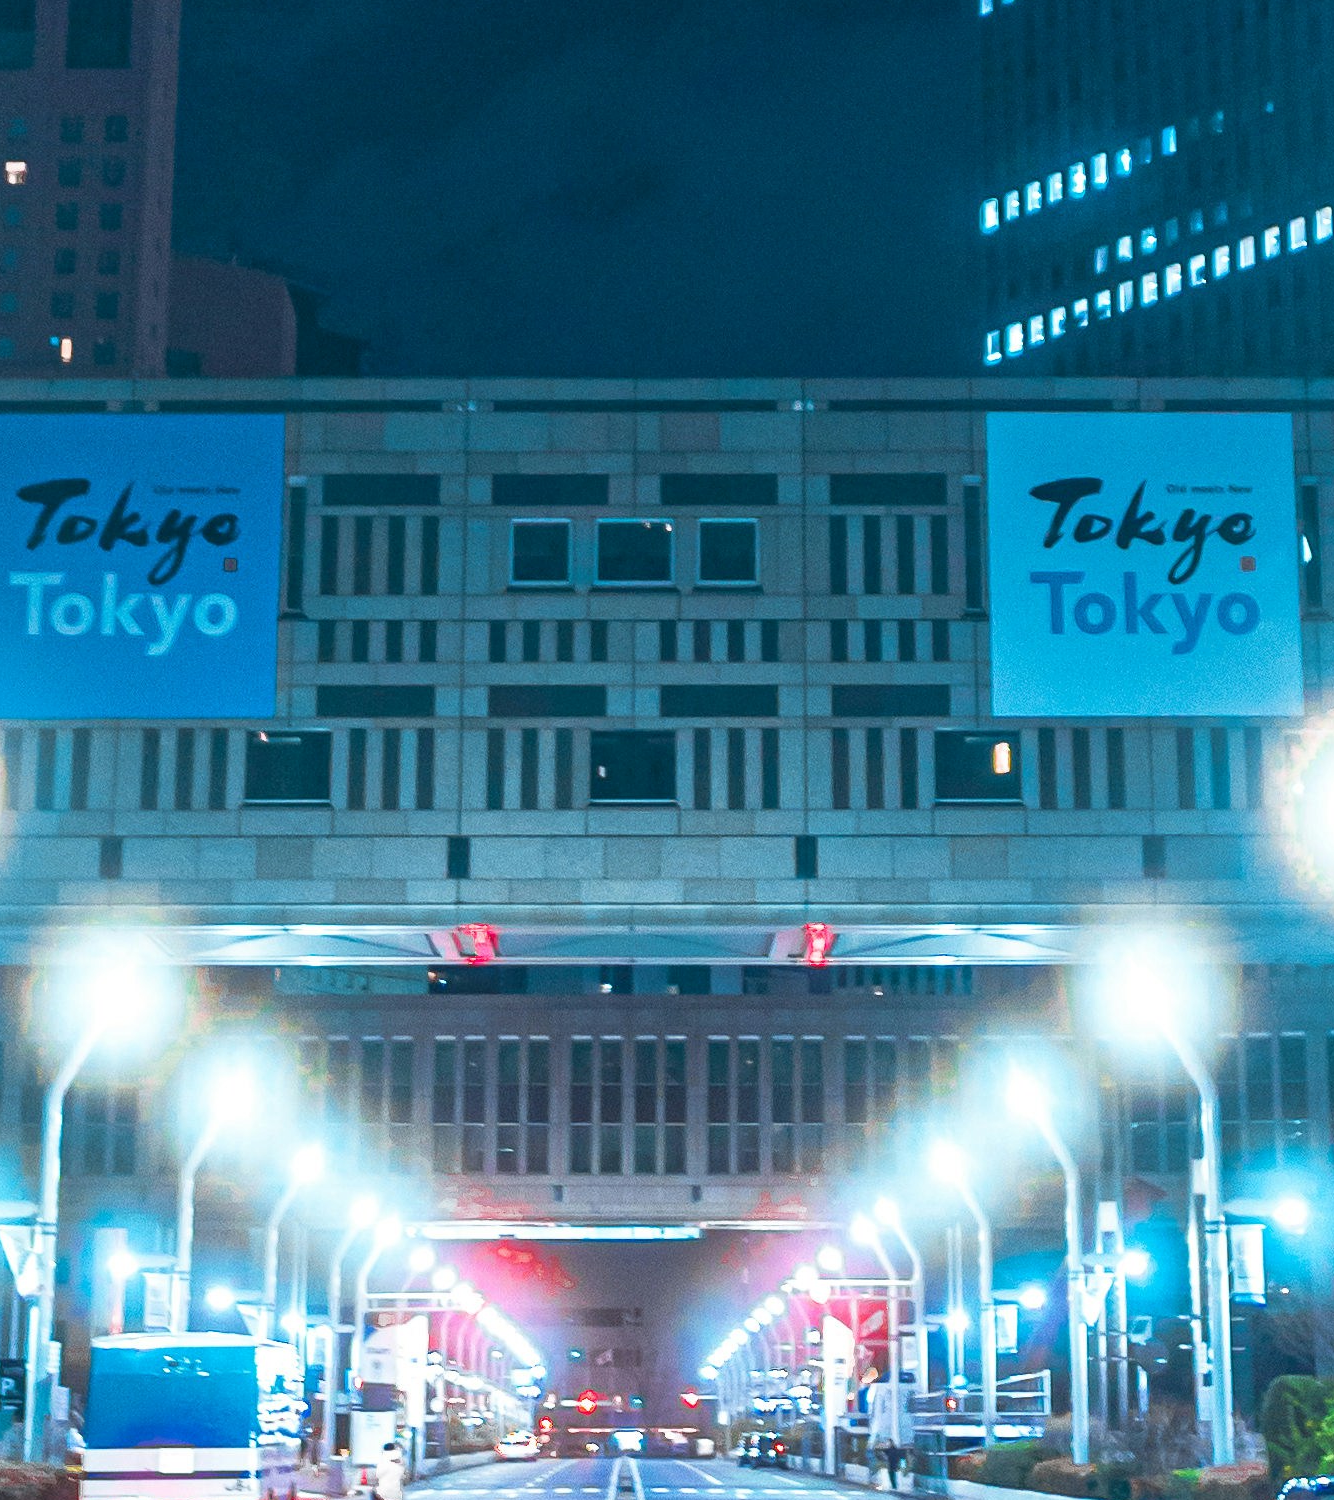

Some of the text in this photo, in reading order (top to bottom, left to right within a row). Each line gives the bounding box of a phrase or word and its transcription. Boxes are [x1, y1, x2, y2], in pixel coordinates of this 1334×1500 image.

[17, 478, 239, 585] Tokyo
[1029, 477, 1256, 585] Tokyo
[9, 572, 238, 656] Tokyo
[1030, 572, 1260, 655] Tokyo
[0, 1377, 15, 1396] P
